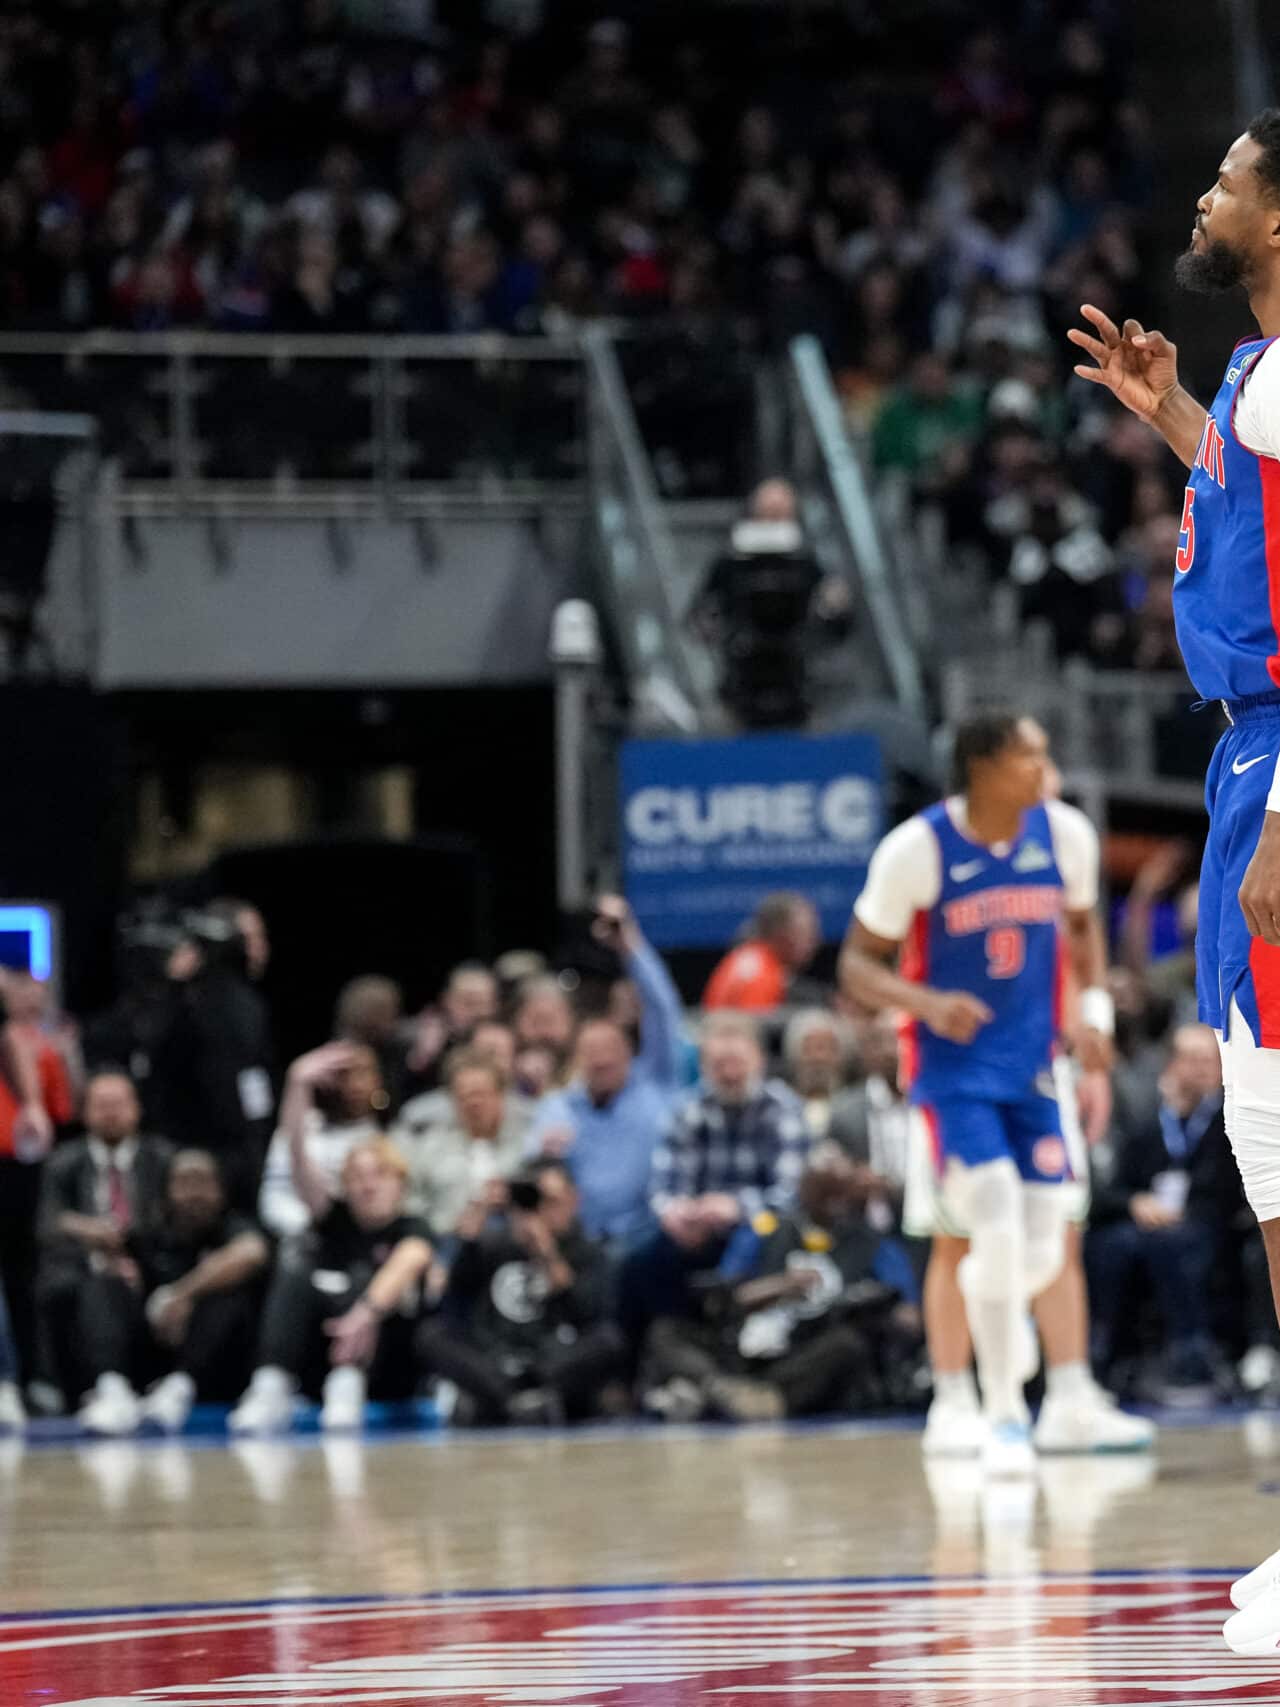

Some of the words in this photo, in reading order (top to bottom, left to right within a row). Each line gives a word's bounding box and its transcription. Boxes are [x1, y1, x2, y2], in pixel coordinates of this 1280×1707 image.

[1176, 487, 1196, 574] 5
[625, 782, 814, 845] CURE
[985, 926, 1026, 979] 9
